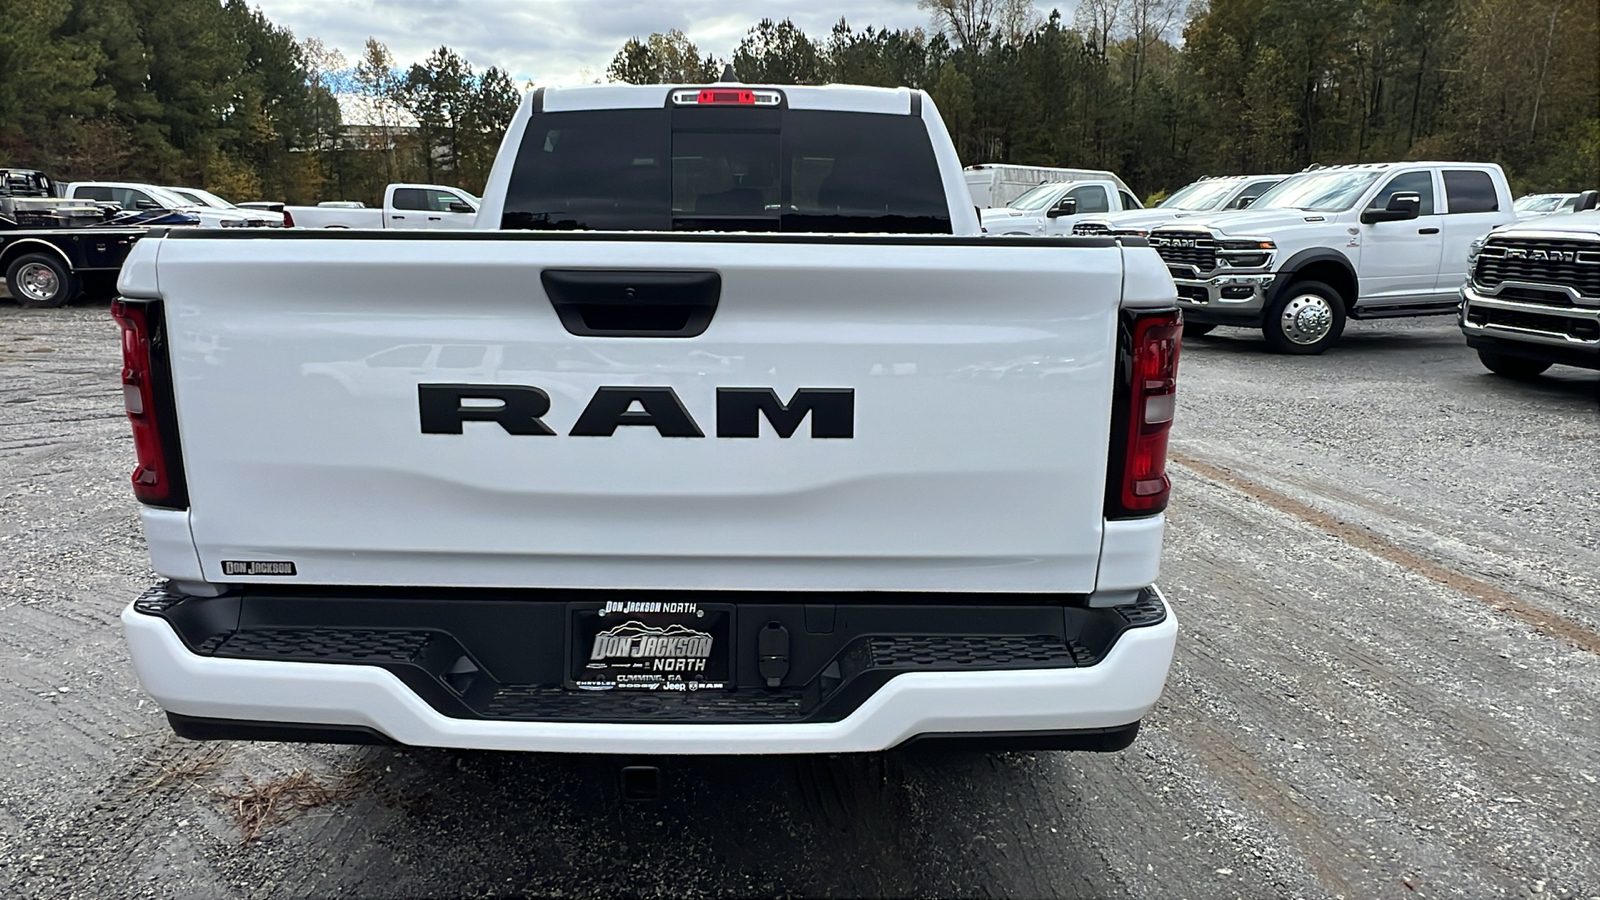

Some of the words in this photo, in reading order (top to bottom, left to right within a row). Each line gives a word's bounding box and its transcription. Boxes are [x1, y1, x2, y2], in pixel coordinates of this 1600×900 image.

[1160, 239, 1194, 247] RAM
[1507, 248, 1575, 261] RAM
[418, 383, 855, 439] RAM
[226, 561, 247, 574] DON
[247, 561, 292, 574] JACKSON
[605, 601, 623, 613] DON
[623, 601, 662, 613] JACKSON
[662, 602, 697, 613] NORTH
[590, 636, 633, 660] DON
[630, 636, 714, 658] JACKSON
[653, 658, 706, 671] NORTH
[662, 681, 686, 691] Jeep
